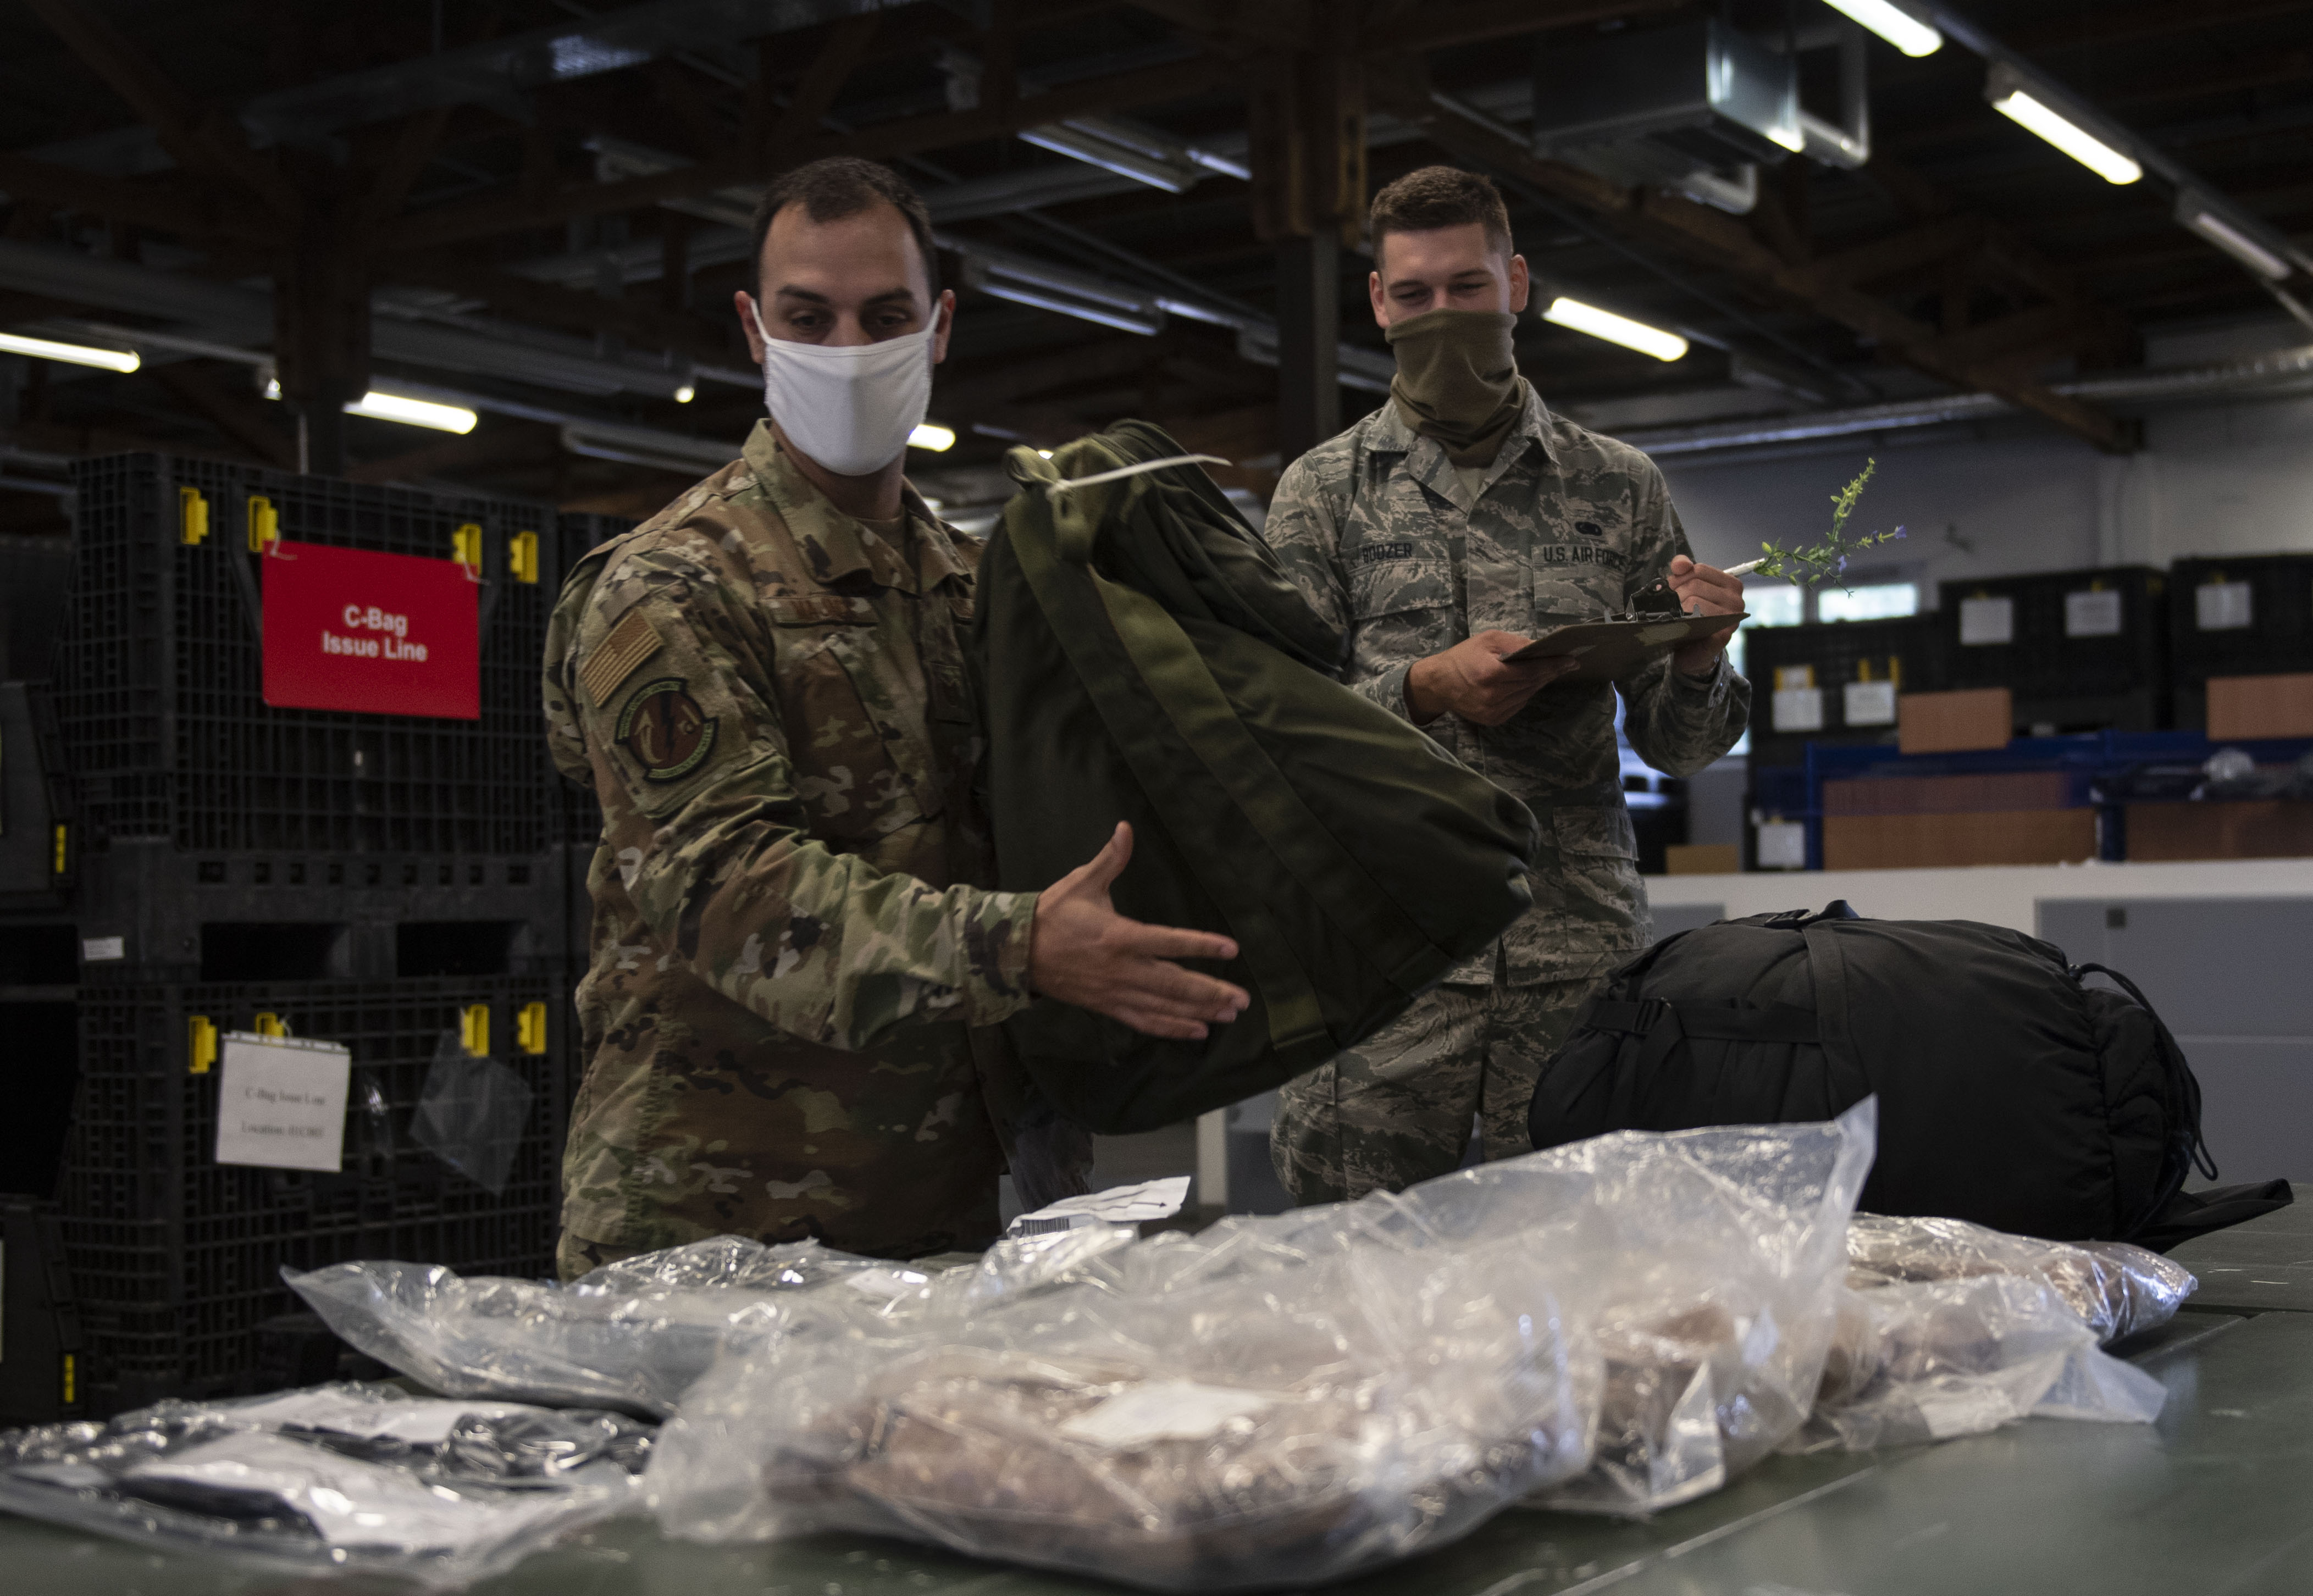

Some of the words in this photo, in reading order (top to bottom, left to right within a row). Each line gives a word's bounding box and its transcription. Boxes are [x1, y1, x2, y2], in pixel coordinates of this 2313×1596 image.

[1363, 543, 1412, 563] BOOZER
[1543, 546, 1568, 562] U.S.
[1572, 546, 1593, 563] AIR
[343, 603, 408, 637] C-Bag
[322, 630, 379, 657] Issue
[384, 637, 428, 663] Line
